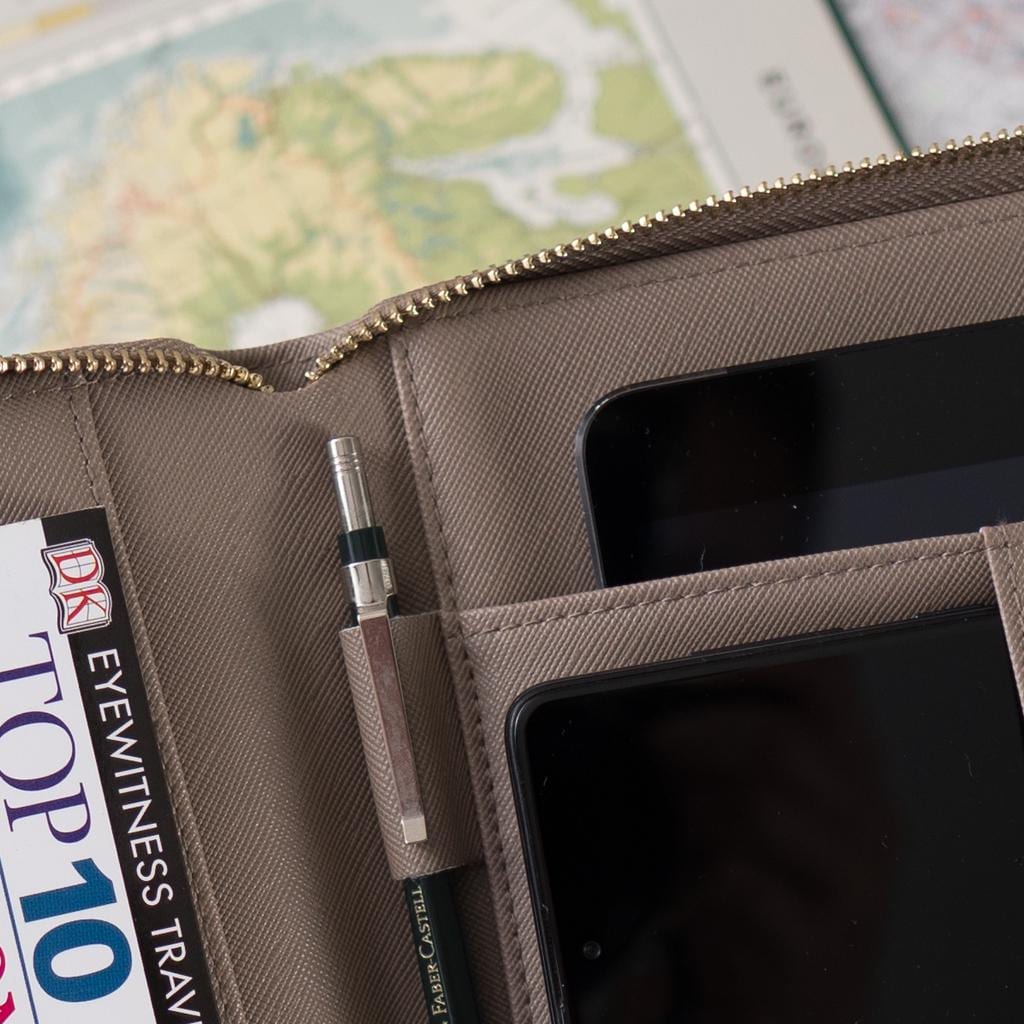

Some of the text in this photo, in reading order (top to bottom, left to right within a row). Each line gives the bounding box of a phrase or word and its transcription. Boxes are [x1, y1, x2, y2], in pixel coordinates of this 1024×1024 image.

[52, 548, 107, 625] DK
[0, 631, 132, 1003] TOP 10
[88, 648, 174, 906] EYEWITNESS
